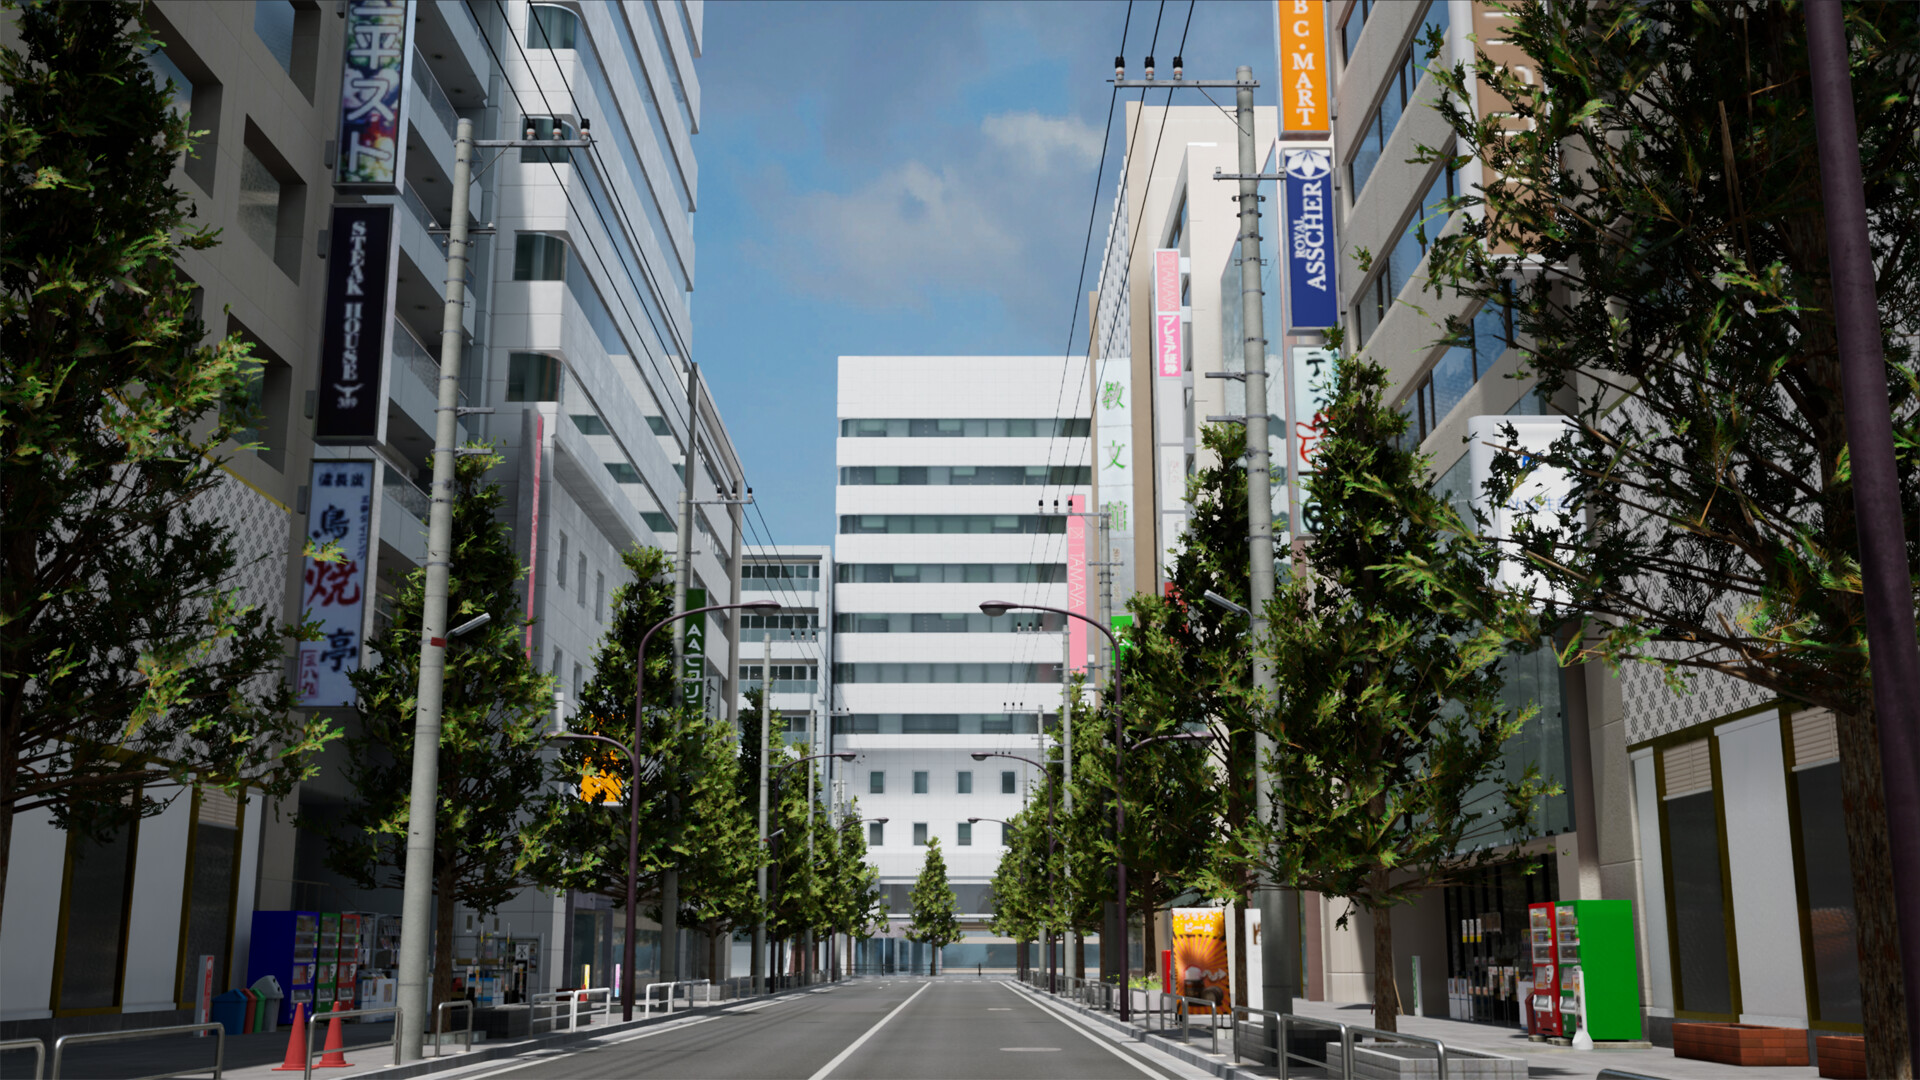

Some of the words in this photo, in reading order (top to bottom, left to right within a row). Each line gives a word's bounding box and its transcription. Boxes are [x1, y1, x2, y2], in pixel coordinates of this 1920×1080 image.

[346, 3, 404, 173] 平スト
[346, 220, 368, 296] STEAK
[1294, 216, 1306, 259] ROYAL
[1302, 180, 1327, 292] ASSCHER
[1162, 265, 1176, 311] TAMAYA
[341, 302, 364, 381] HOUSE
[1163, 315, 1178, 375] プレミア証券
[1101, 381, 1127, 532] 教文館
[1068, 550, 1085, 610] TAMAYA
[1183, 922, 1214, 933] ビール
